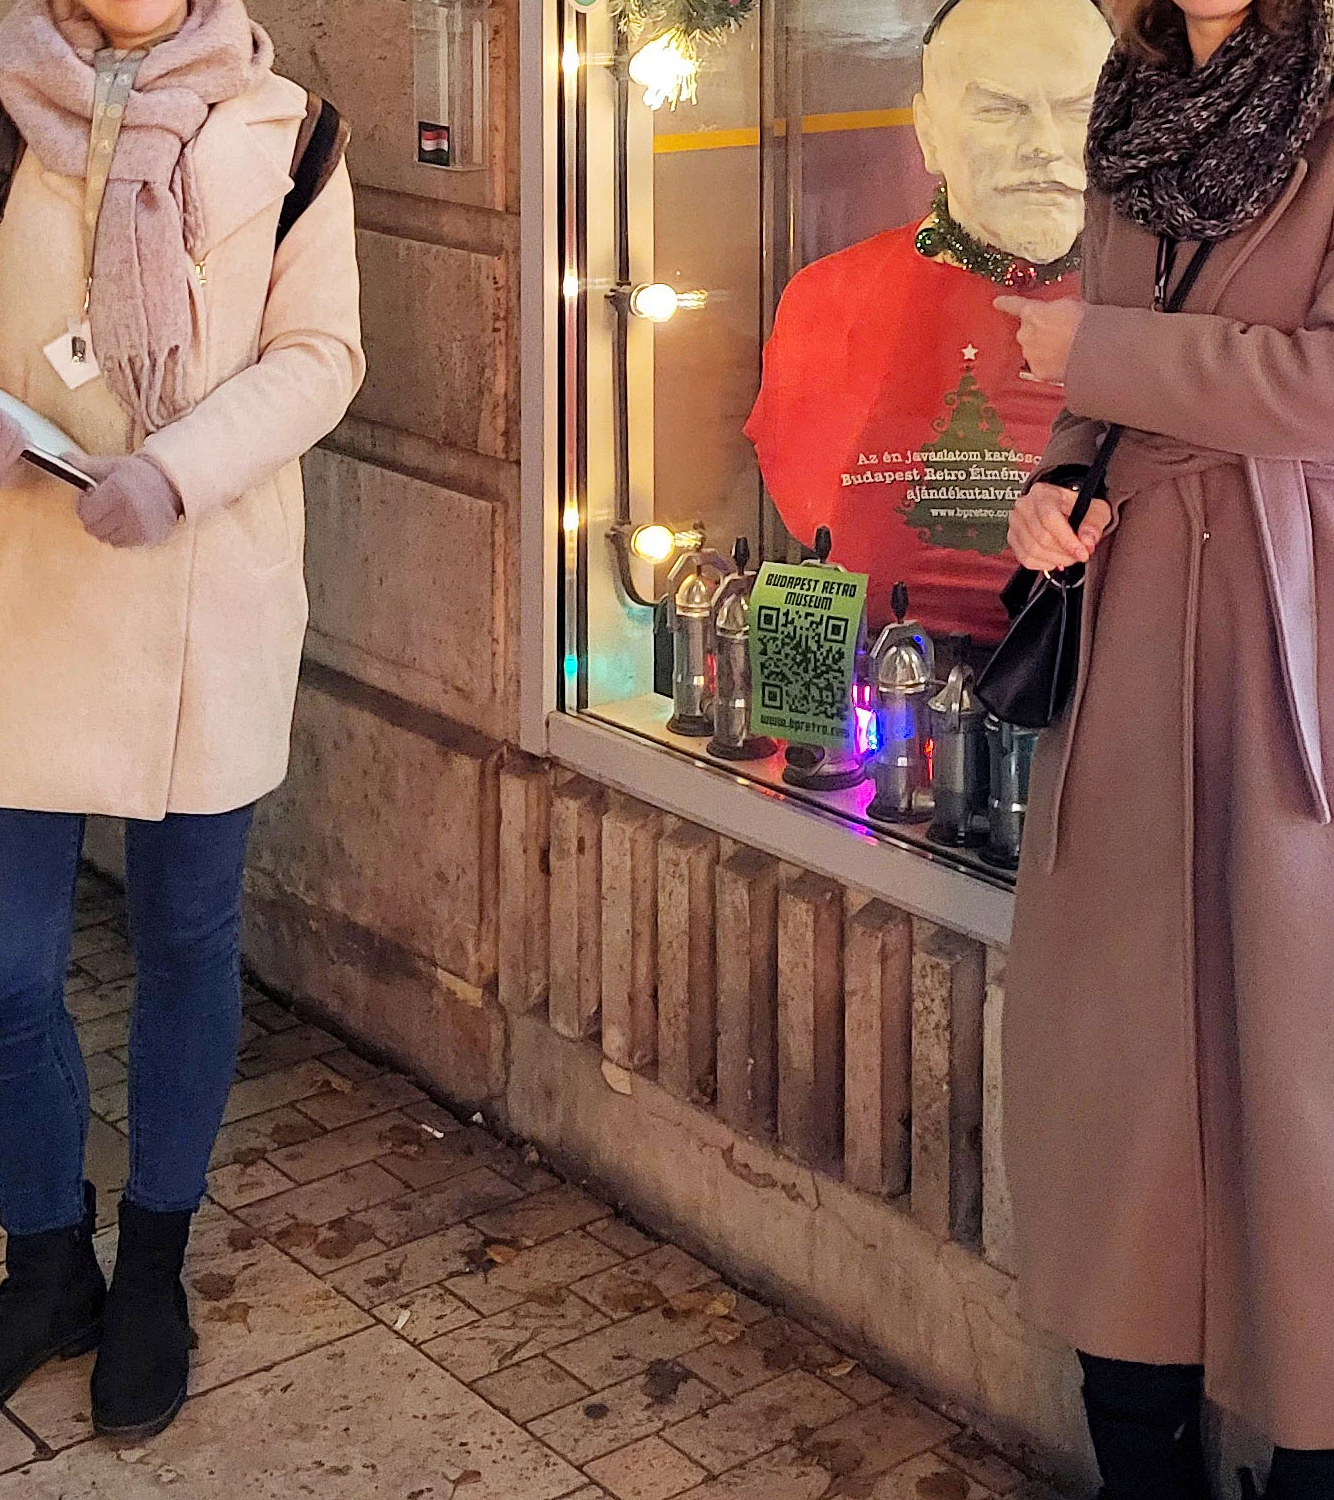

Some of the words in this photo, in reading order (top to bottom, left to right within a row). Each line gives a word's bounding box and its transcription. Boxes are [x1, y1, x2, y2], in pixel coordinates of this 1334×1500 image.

[857, 453, 878, 466] Az
[882, 450, 903, 463] én
[906, 449, 981, 465] javaslatom
[841, 468, 920, 487] Budapest
[924, 467, 966, 481] Retro
[969, 464, 1031, 483] Élmény
[765, 573, 820, 593] BUDAPEST
[821, 580, 857, 598] RETRO
[784, 591, 833, 611] MUSEUM
